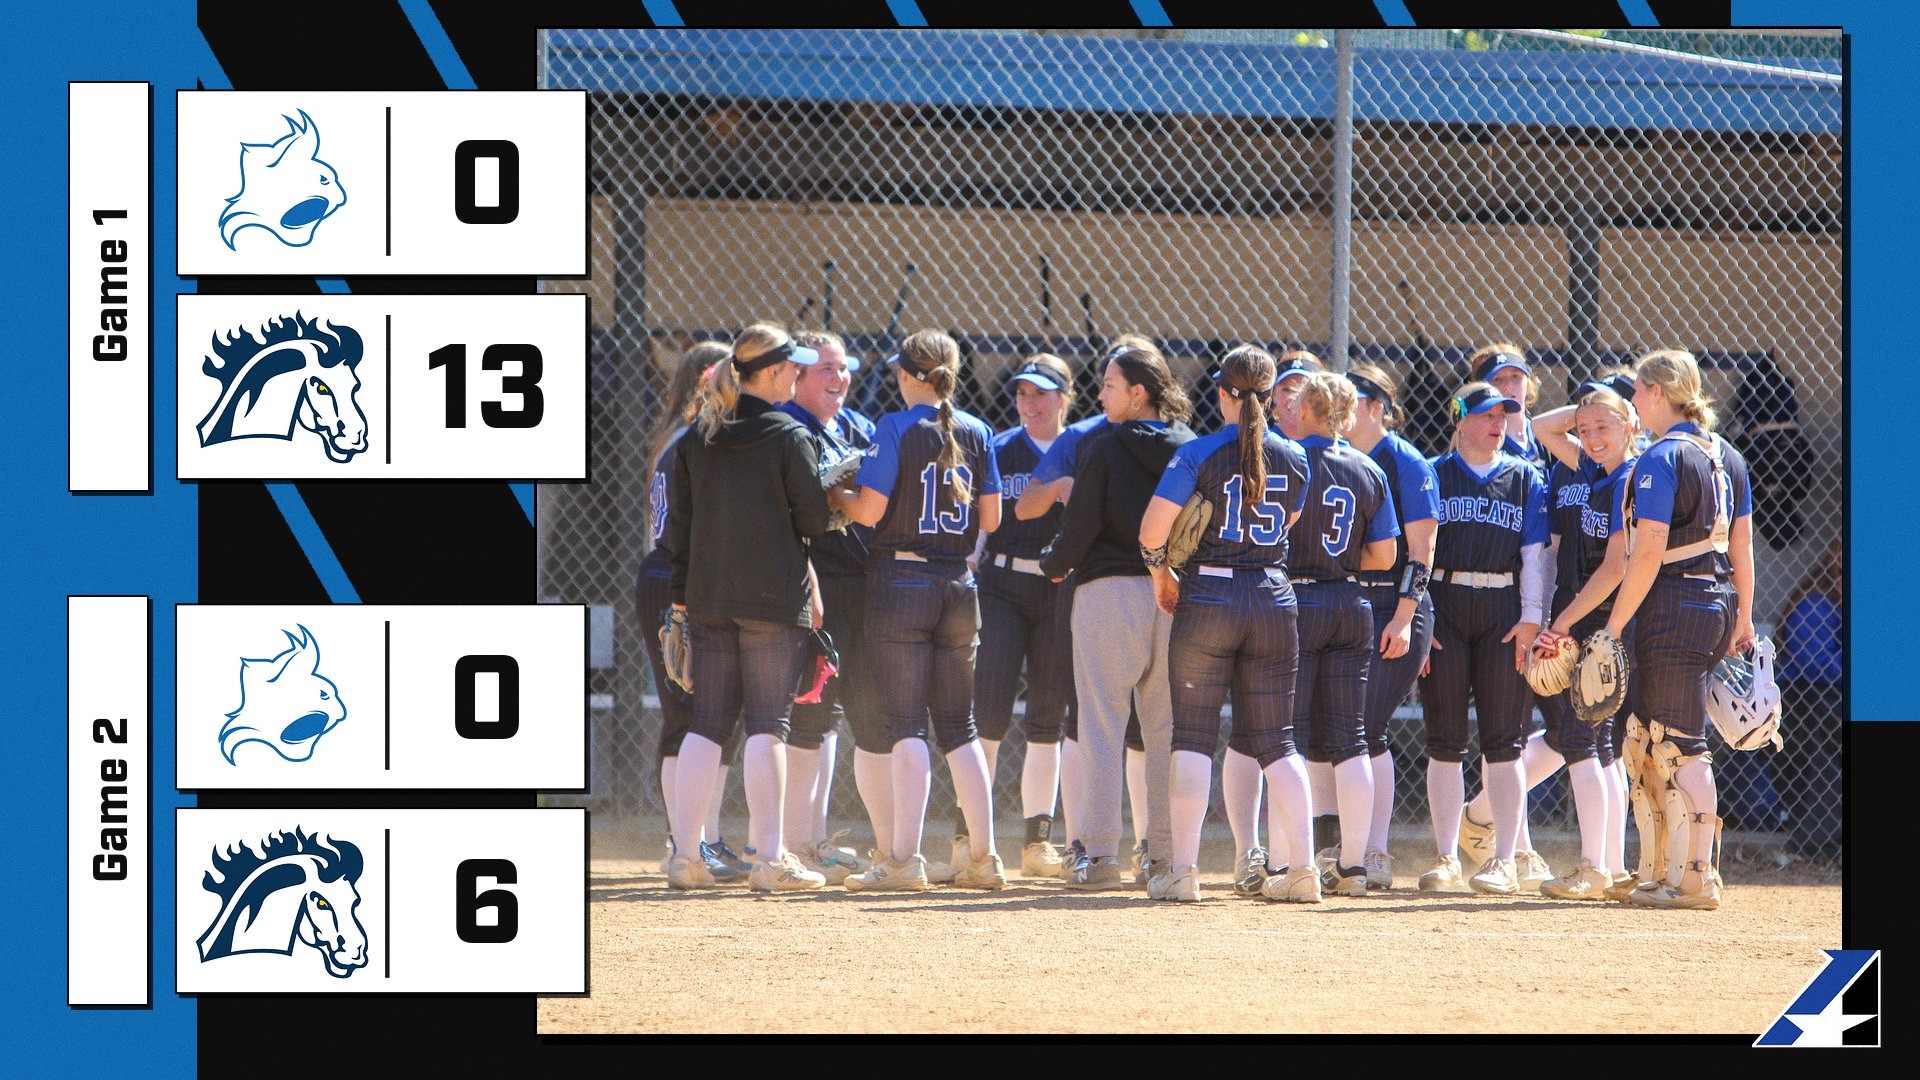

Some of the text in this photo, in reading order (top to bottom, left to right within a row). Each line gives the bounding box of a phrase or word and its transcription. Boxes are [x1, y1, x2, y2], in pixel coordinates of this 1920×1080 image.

[919, 462, 973, 535] 13
[1219, 474, 1288, 545] 15
[1322, 485, 1356, 557] 3
[1438, 496, 1523, 532] BOBCATS
